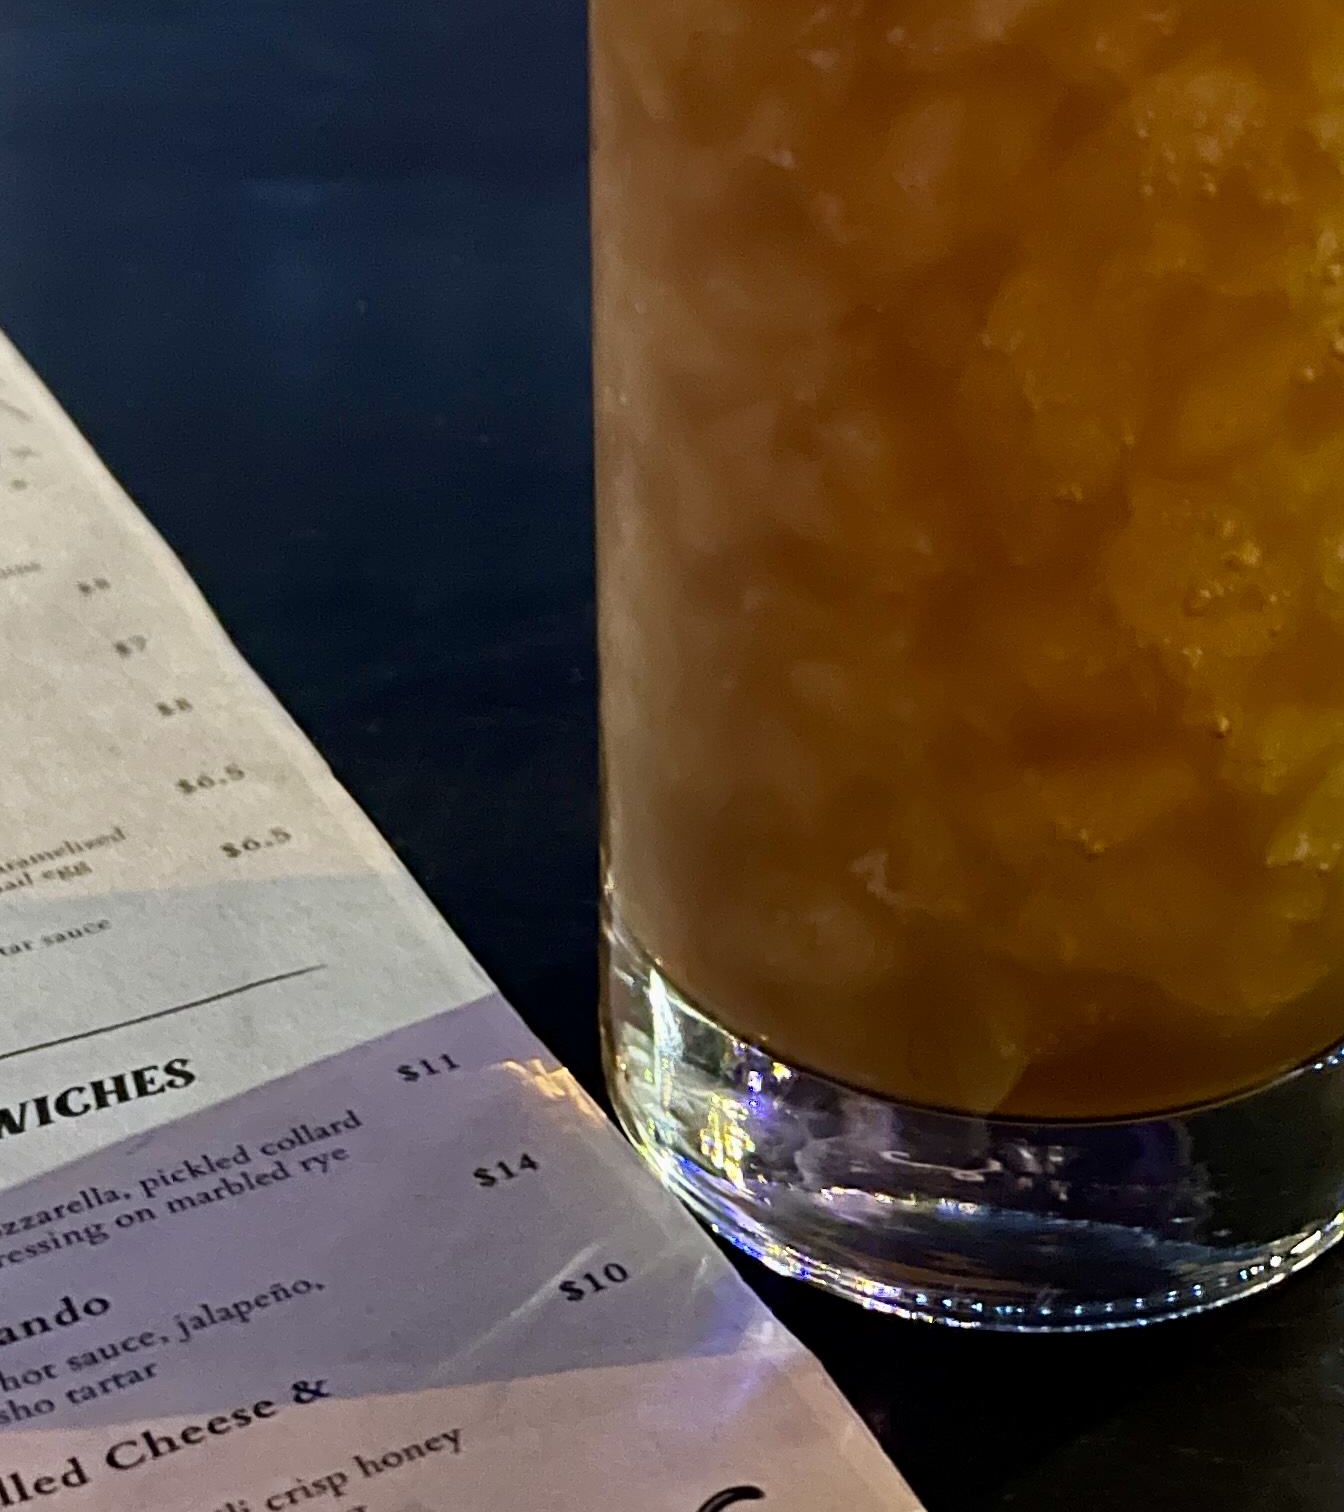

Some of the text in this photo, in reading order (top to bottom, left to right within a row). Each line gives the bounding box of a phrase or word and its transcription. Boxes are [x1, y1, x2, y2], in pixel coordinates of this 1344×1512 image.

[39, 918, 113, 946] sauce
[394, 1052, 462, 1085] $11
[113, 1204, 158, 1231] on
[166, 1159, 292, 1217] marbled
[300, 1144, 351, 1181] rye
[139, 1142, 253, 1201] pickled
[259, 1108, 365, 1162] collard
[472, 1152, 541, 1189] $14
[558, 1262, 630, 1303] $10
[67, 1326, 170, 1374] sauce,
[173, 1276, 325, 1344] jalapeño,
[64, 1359, 159, 1406] tartar
[103, 1397, 279, 1471] Cheese
[291, 1376, 333, 1405] &
[265, 1424, 465, 1512] crisp honey
